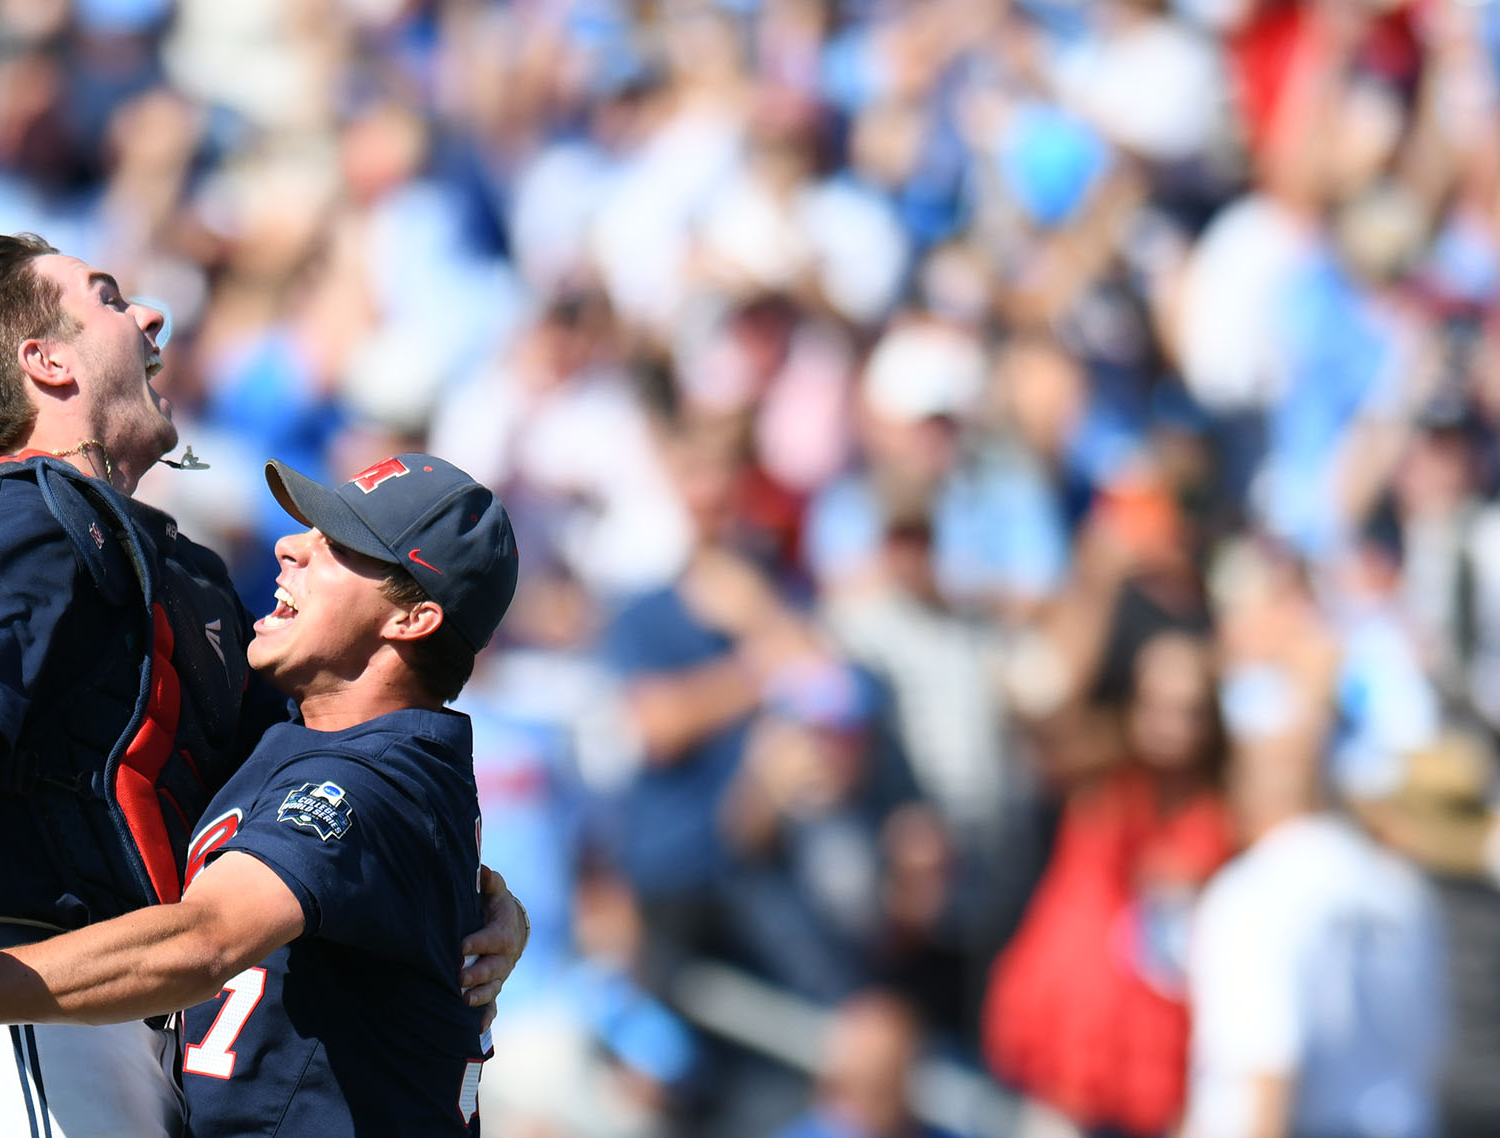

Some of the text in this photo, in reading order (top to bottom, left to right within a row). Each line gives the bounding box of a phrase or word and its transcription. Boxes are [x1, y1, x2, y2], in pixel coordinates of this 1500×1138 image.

[283, 802, 342, 834] WORLD SERIES
[297, 796, 338, 818] COLLEGE
